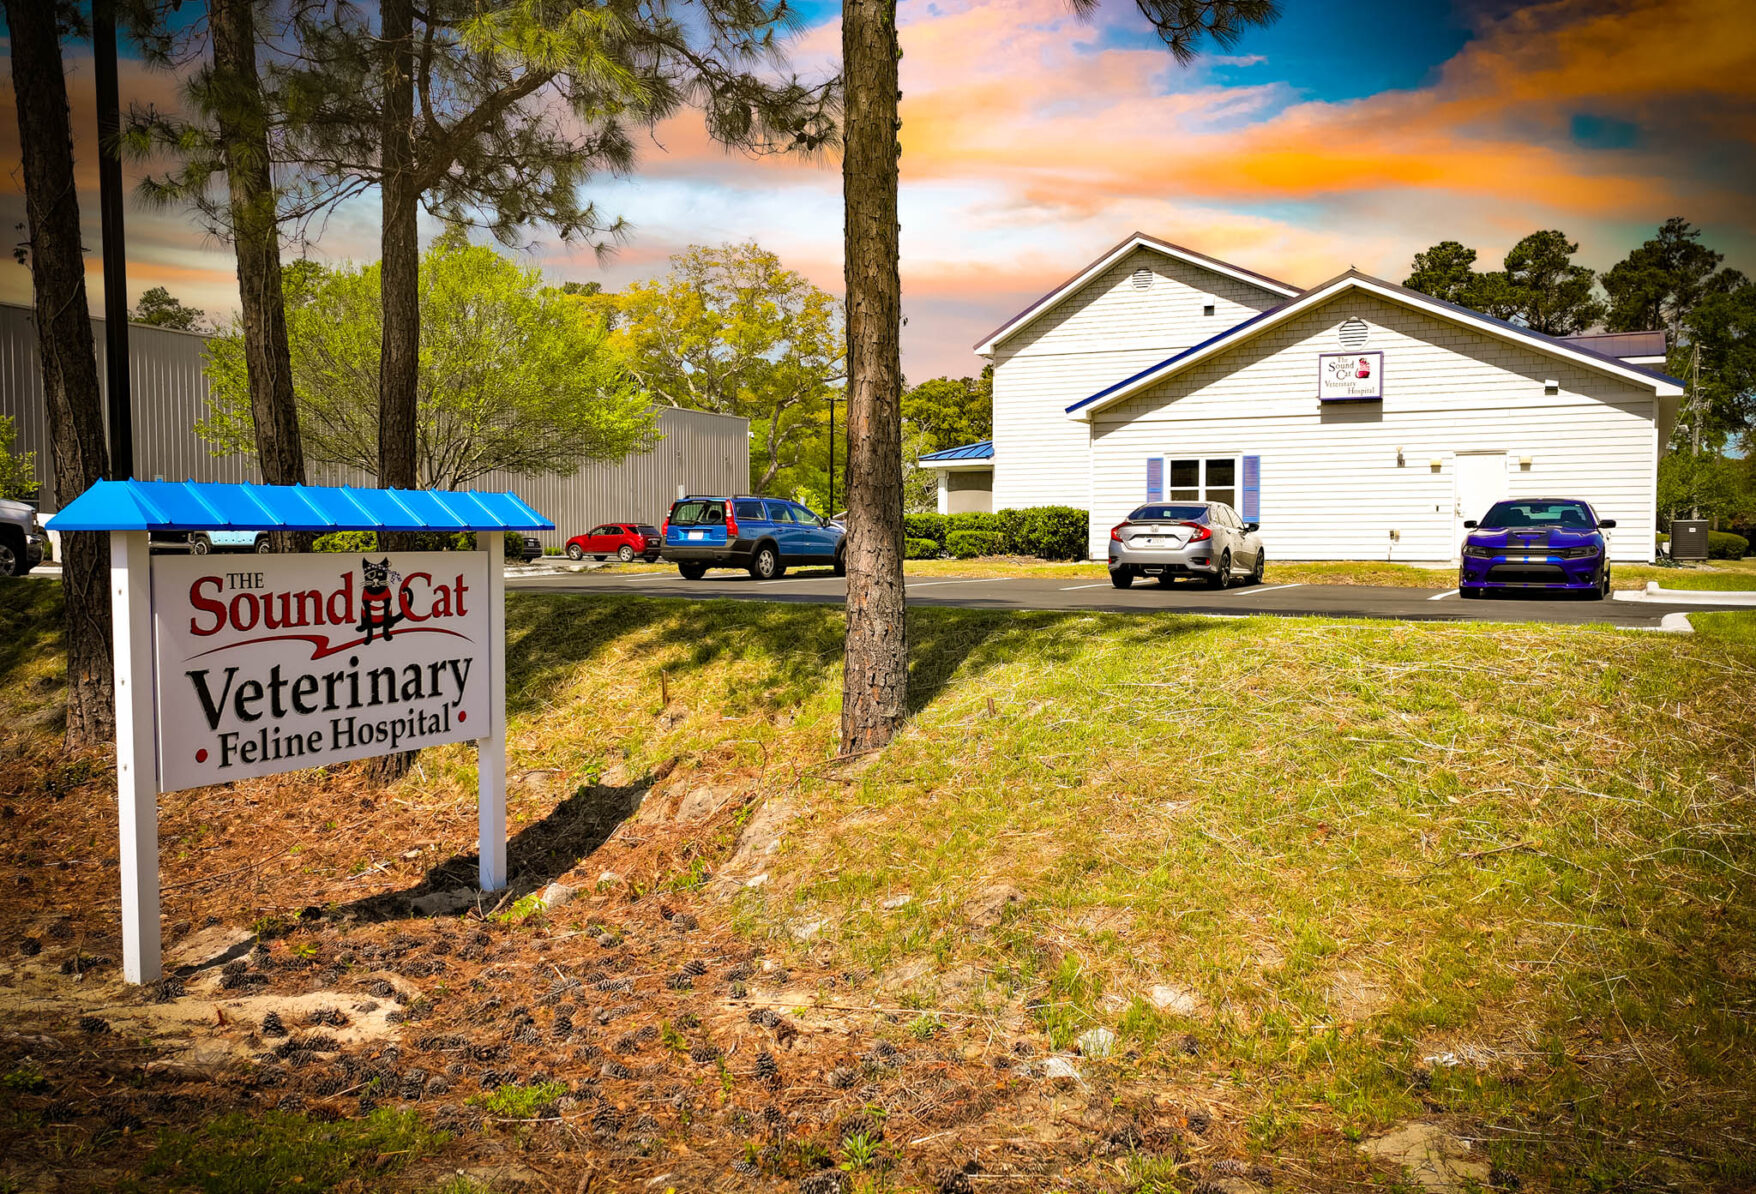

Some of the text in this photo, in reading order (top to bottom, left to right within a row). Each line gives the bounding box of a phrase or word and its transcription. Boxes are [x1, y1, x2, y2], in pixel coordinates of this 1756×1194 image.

[1328, 360, 1355, 372] Sound
[1336, 369, 1351, 380] Cat
[1347, 387, 1375, 395] Hospital
[226, 572, 264, 590] THE
[189, 571, 469, 637] Sound Cat
[185, 655, 473, 731] Veterinary
[218, 703, 452, 768] Feline Hospital
